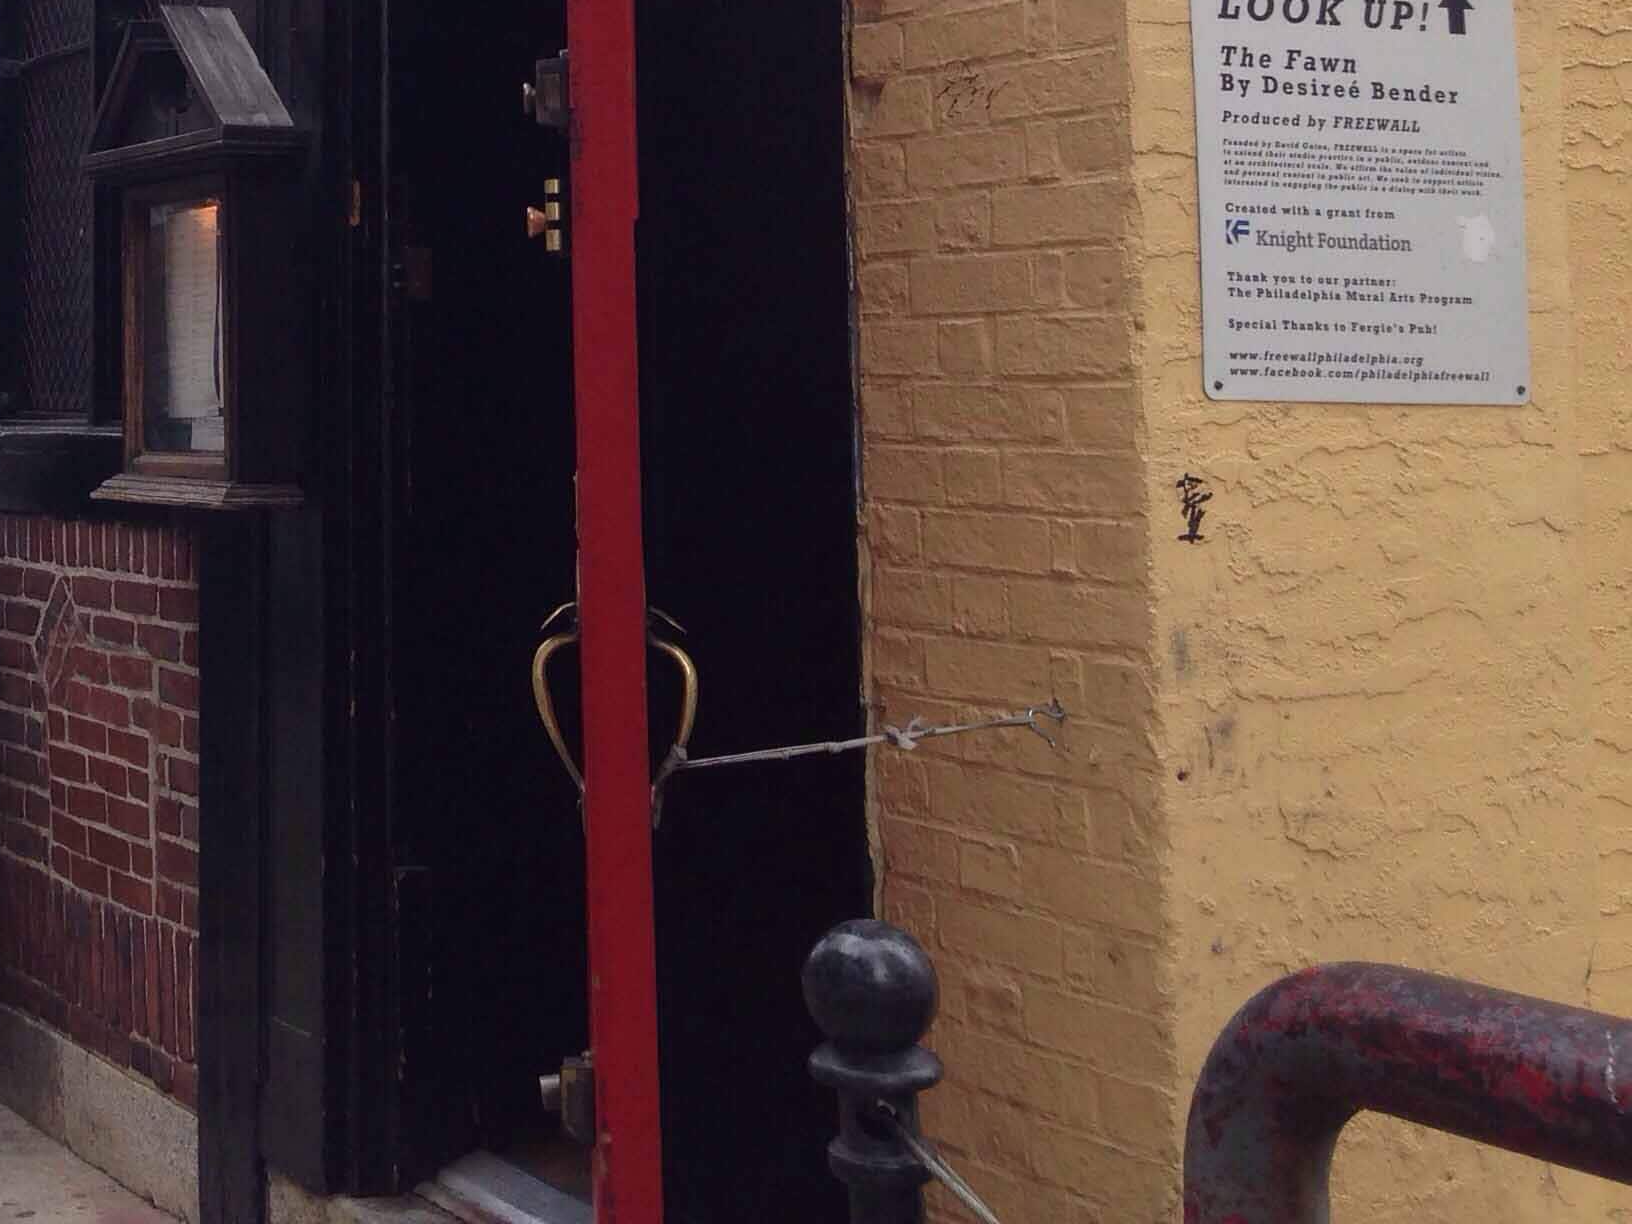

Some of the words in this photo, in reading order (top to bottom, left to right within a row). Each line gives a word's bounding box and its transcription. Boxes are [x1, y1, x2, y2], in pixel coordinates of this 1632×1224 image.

[1221, 45, 1272, 68] The
[1284, 49, 1357, 74] Fawn
[1220, 73, 1251, 98] By
[1262, 75, 1360, 98] Desireé
[1371, 81, 1459, 104] Bender
[1221, 110, 1301, 127] Produced
[1307, 115, 1327, 132] by
[1333, 116, 1420, 133] FREEWALL
[1225, 202, 1277, 215] Created
[1281, 205, 1310, 216] with
[1326, 208, 1361, 219] grant
[1365, 208, 1395, 219] from
[1256, 229, 1314, 252] Knight
[1318, 232, 1413, 252] Foundation
[1227, 271, 1268, 283] Thank
[1272, 274, 1296, 285] you
[1300, 274, 1312, 284] to
[1318, 276, 1339, 286] our
[1344, 276, 1397, 288] partner:
[1227, 287, 1251, 298] The
[1257, 288, 1341, 303] Philadelphia
[1346, 291, 1385, 303] Mural
[1389, 292, 1415, 304] Arts
[1419, 293, 1473, 306] Program
[1228, 318, 1277, 331] Special
[1283, 319, 1330, 332] Thanks
[1334, 322, 1346, 333] to
[1351, 322, 1405, 335] Fergie's
[1409, 323, 1438, 335] Pub!
[1229, 350, 1424, 366] www.freewallphiladelphia.org
[1230, 366, 1491, 382] www.facebook.com/philadelphiafreewall
